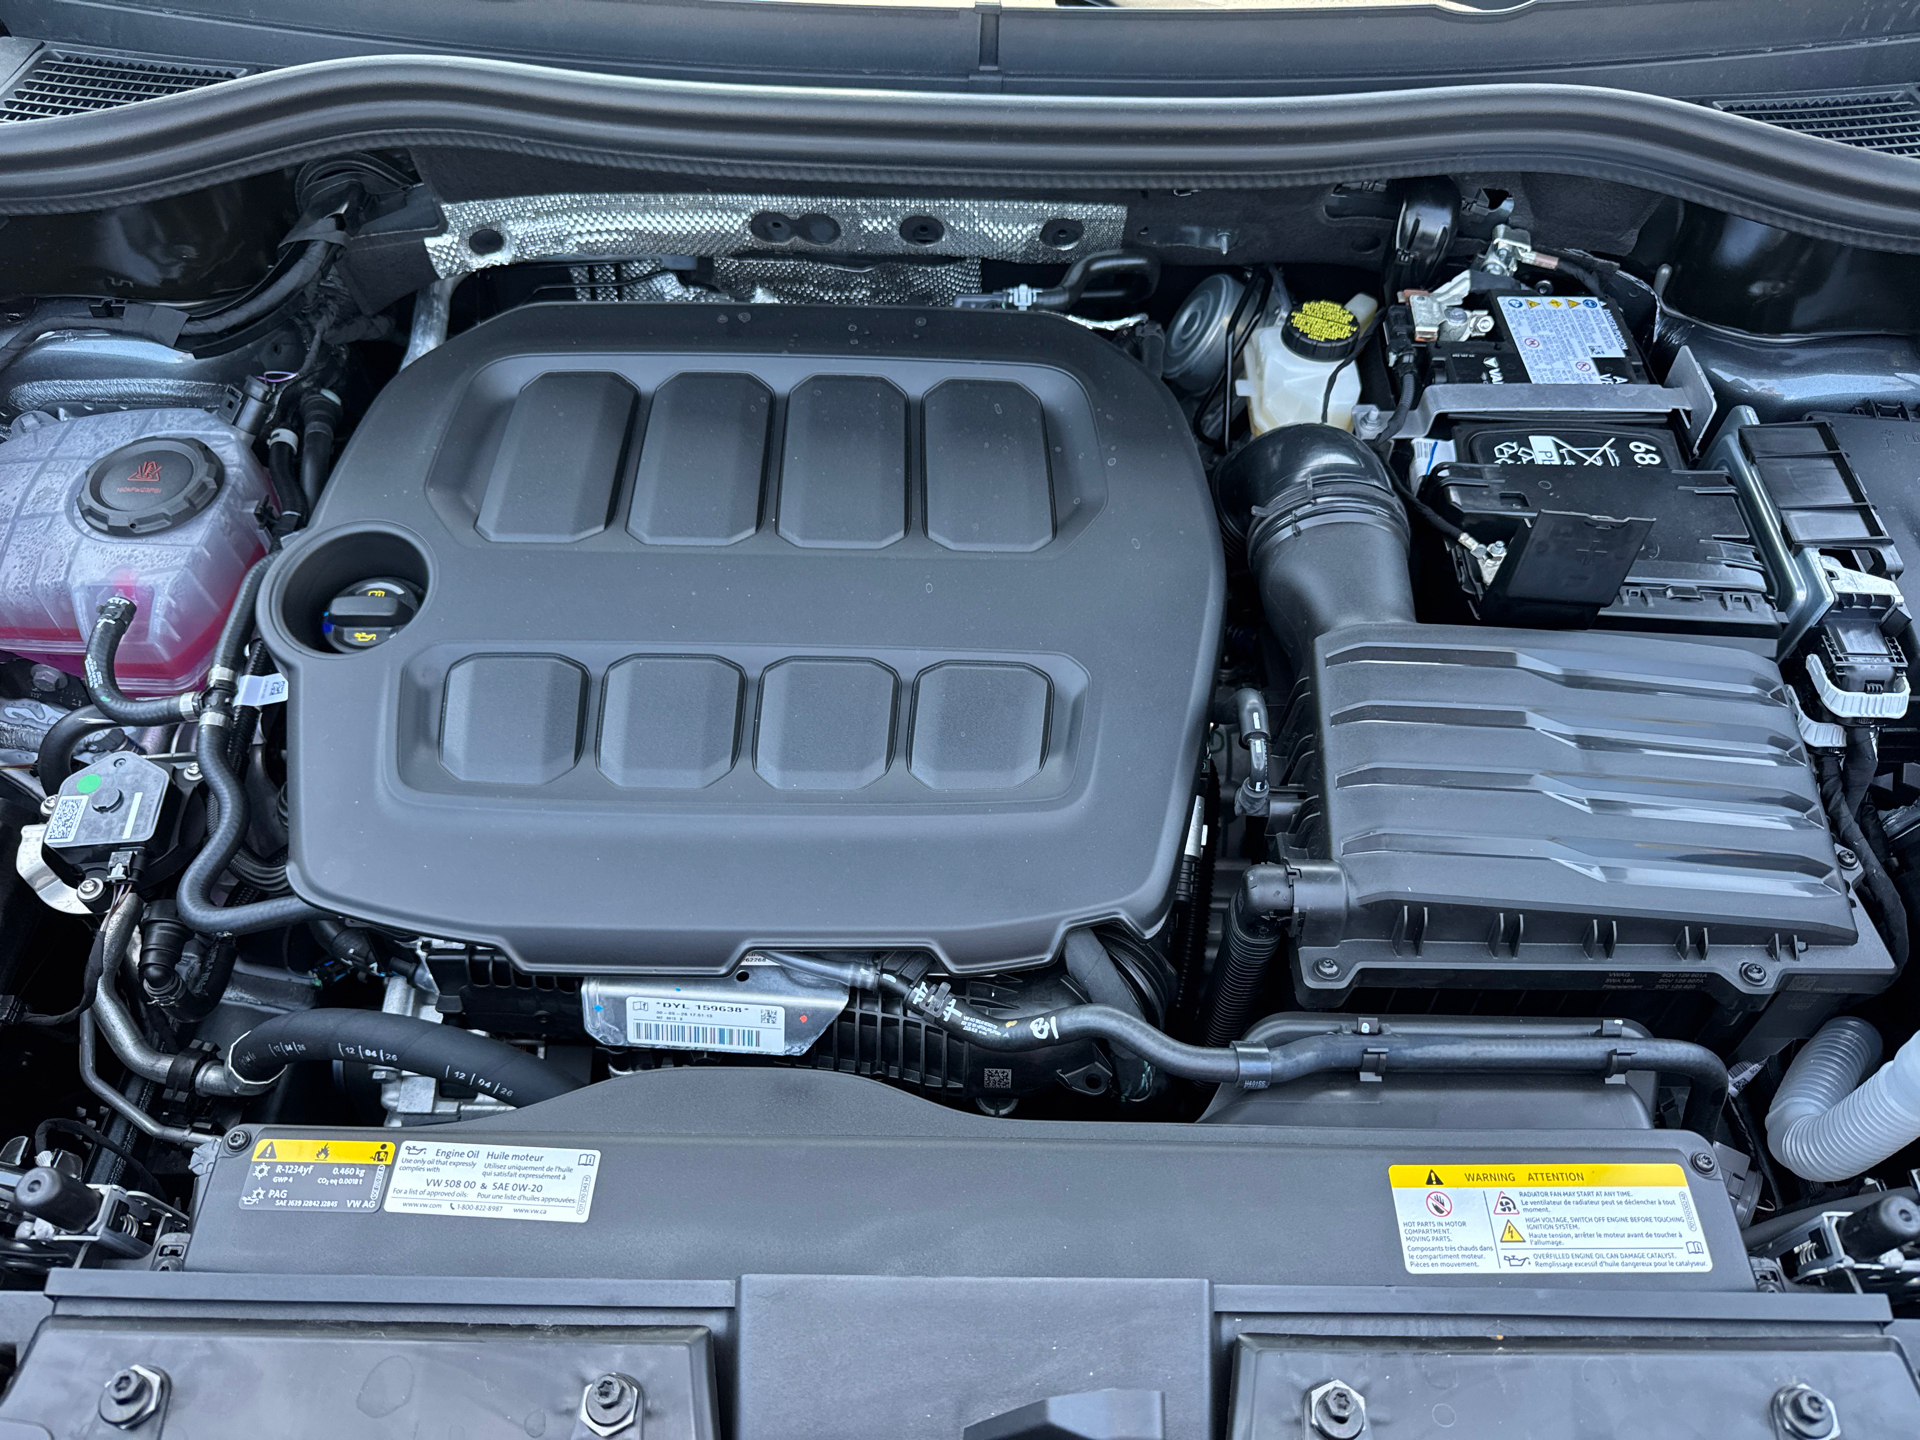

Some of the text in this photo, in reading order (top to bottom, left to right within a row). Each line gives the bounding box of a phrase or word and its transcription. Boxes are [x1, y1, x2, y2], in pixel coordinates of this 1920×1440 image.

[436, 1149, 480, 1159] Engine Oil
[486, 1151, 544, 1162] Huile moteur
[276, 1165, 314, 1175] R-1234yf
[356, 1168, 365, 1176] kg
[518, 1172, 560, 1180] expressément
[1464, 1173, 1584, 1181] WARNING ATTENTION
[426, 1178, 443, 1187] VW
[444, 1180, 462, 1188] 508
[464, 1180, 476, 1188] 00
[492, 1182, 510, 1191] SAE
[512, 1183, 543, 1192] 0W-20
[268, 1190, 288, 1198] PAG
[517, 1194, 539, 1202] d'huiles
[362, 1200, 376, 1208] AG
[457, 1204, 503, 1212] 1-800-822-8987
